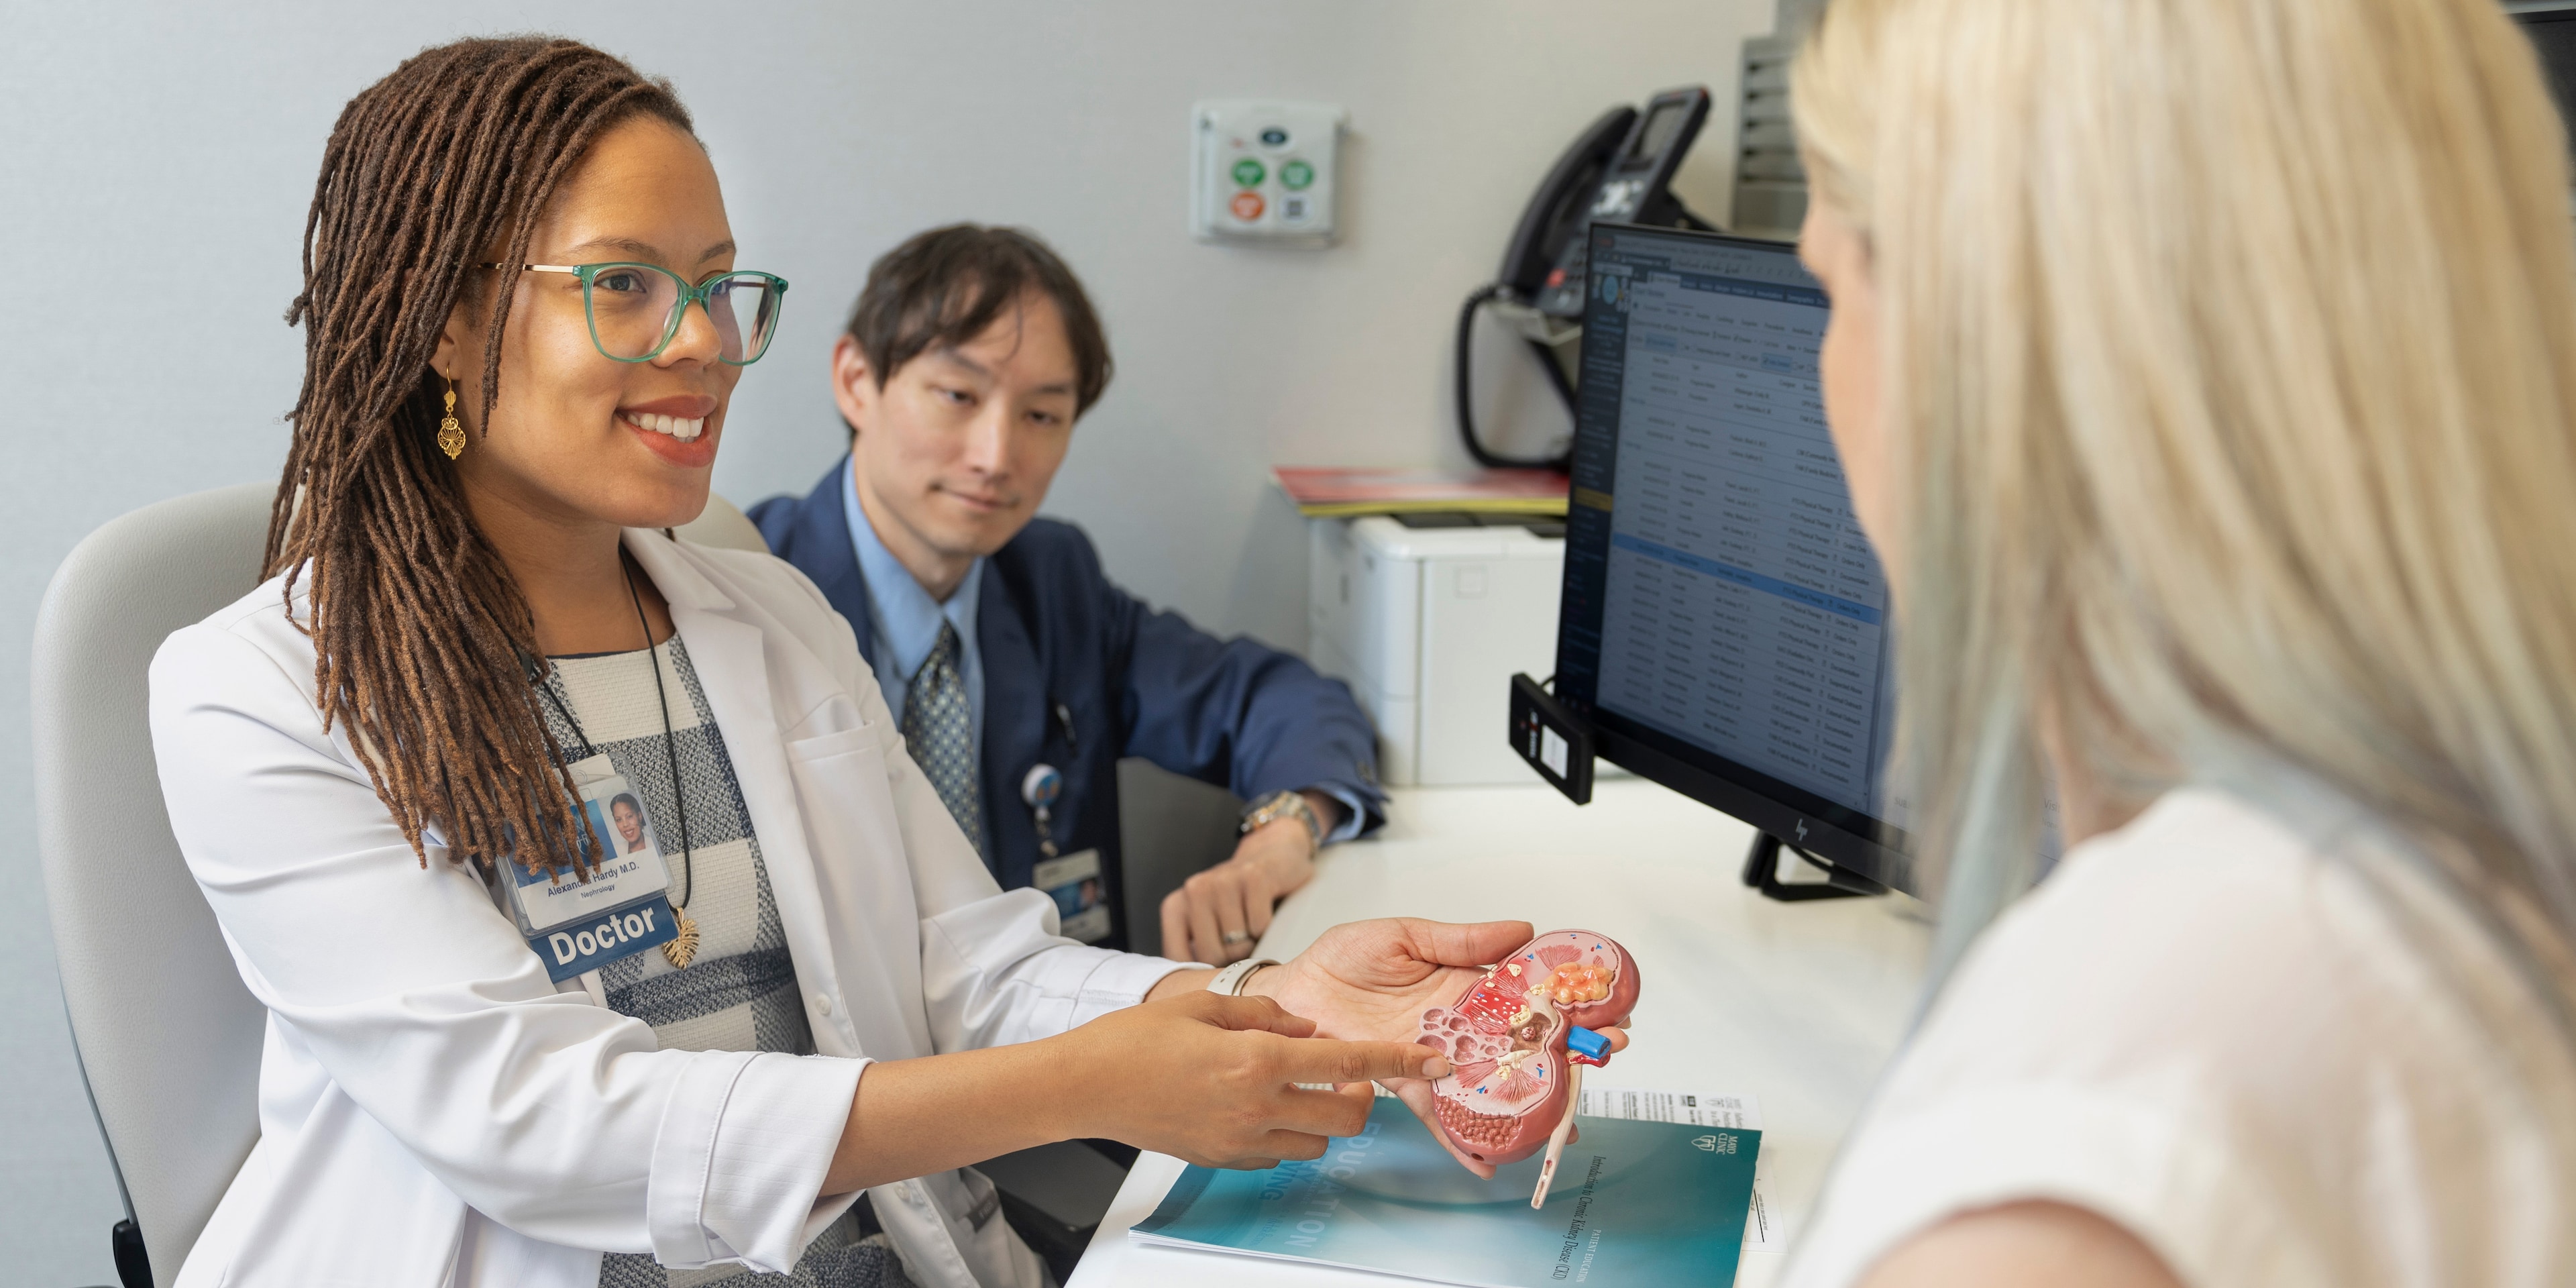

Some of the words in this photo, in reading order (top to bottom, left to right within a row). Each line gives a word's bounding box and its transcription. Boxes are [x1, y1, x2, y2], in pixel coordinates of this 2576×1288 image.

[548, 877, 592, 897] Alexanda
[592, 869, 618, 882] Hardy
[619, 861, 640, 874] M.D.
[581, 883, 615, 898] Nephrology
[548, 907, 655, 965] Doctor
[1715, 1132, 1728, 1155] CLINIC
[1727, 1136, 1738, 1155] MAYO
[1283, 1122, 1381, 1248] EDUCATION
[1583, 1155, 1607, 1193] Introduction
[1572, 1197, 1593, 1219] Chronic
[1562, 1219, 1586, 1240] Kidney
[1587, 1229, 1602, 1253] PATIENT
[1559, 1240, 1578, 1263] Disease
[1551, 1264, 1570, 1281] (CKD)
[1576, 1253, 1594, 1283] EDUCATION
